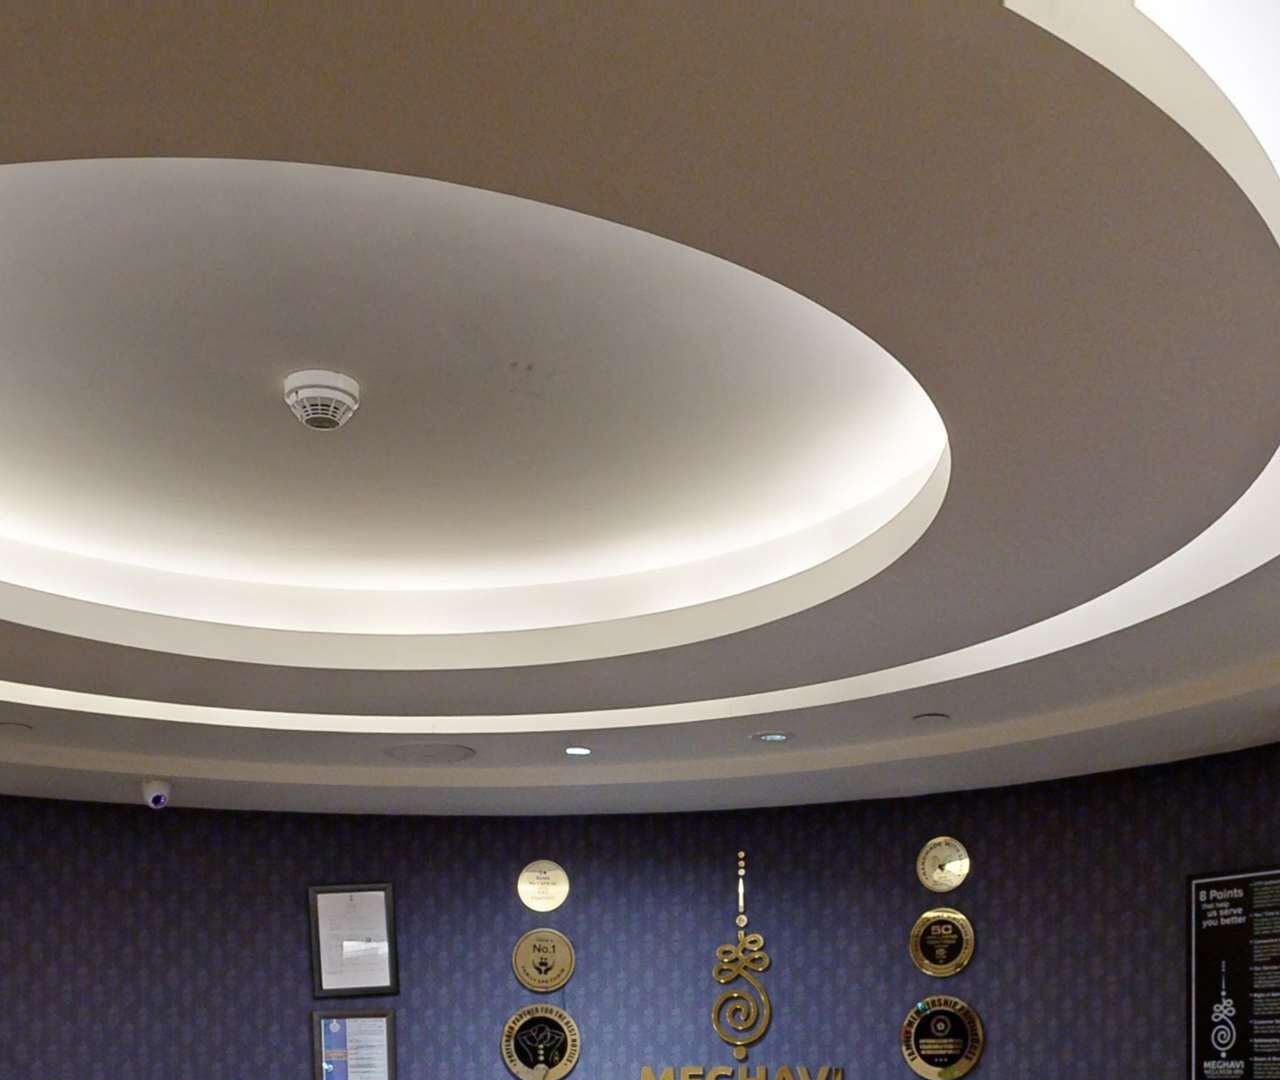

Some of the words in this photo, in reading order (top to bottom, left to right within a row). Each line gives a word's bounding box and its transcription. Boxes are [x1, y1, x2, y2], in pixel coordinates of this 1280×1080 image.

[1199, 890, 1207, 901] 8
[1209, 888, 1244, 901] Points
[1207, 910, 1218, 918] us
[1219, 907, 1243, 917] serve
[1202, 919, 1219, 928] you
[1220, 916, 1247, 926] better
[532, 944, 556, 954] No.1
[1203, 1060, 1245, 1069] MEGHAVI
